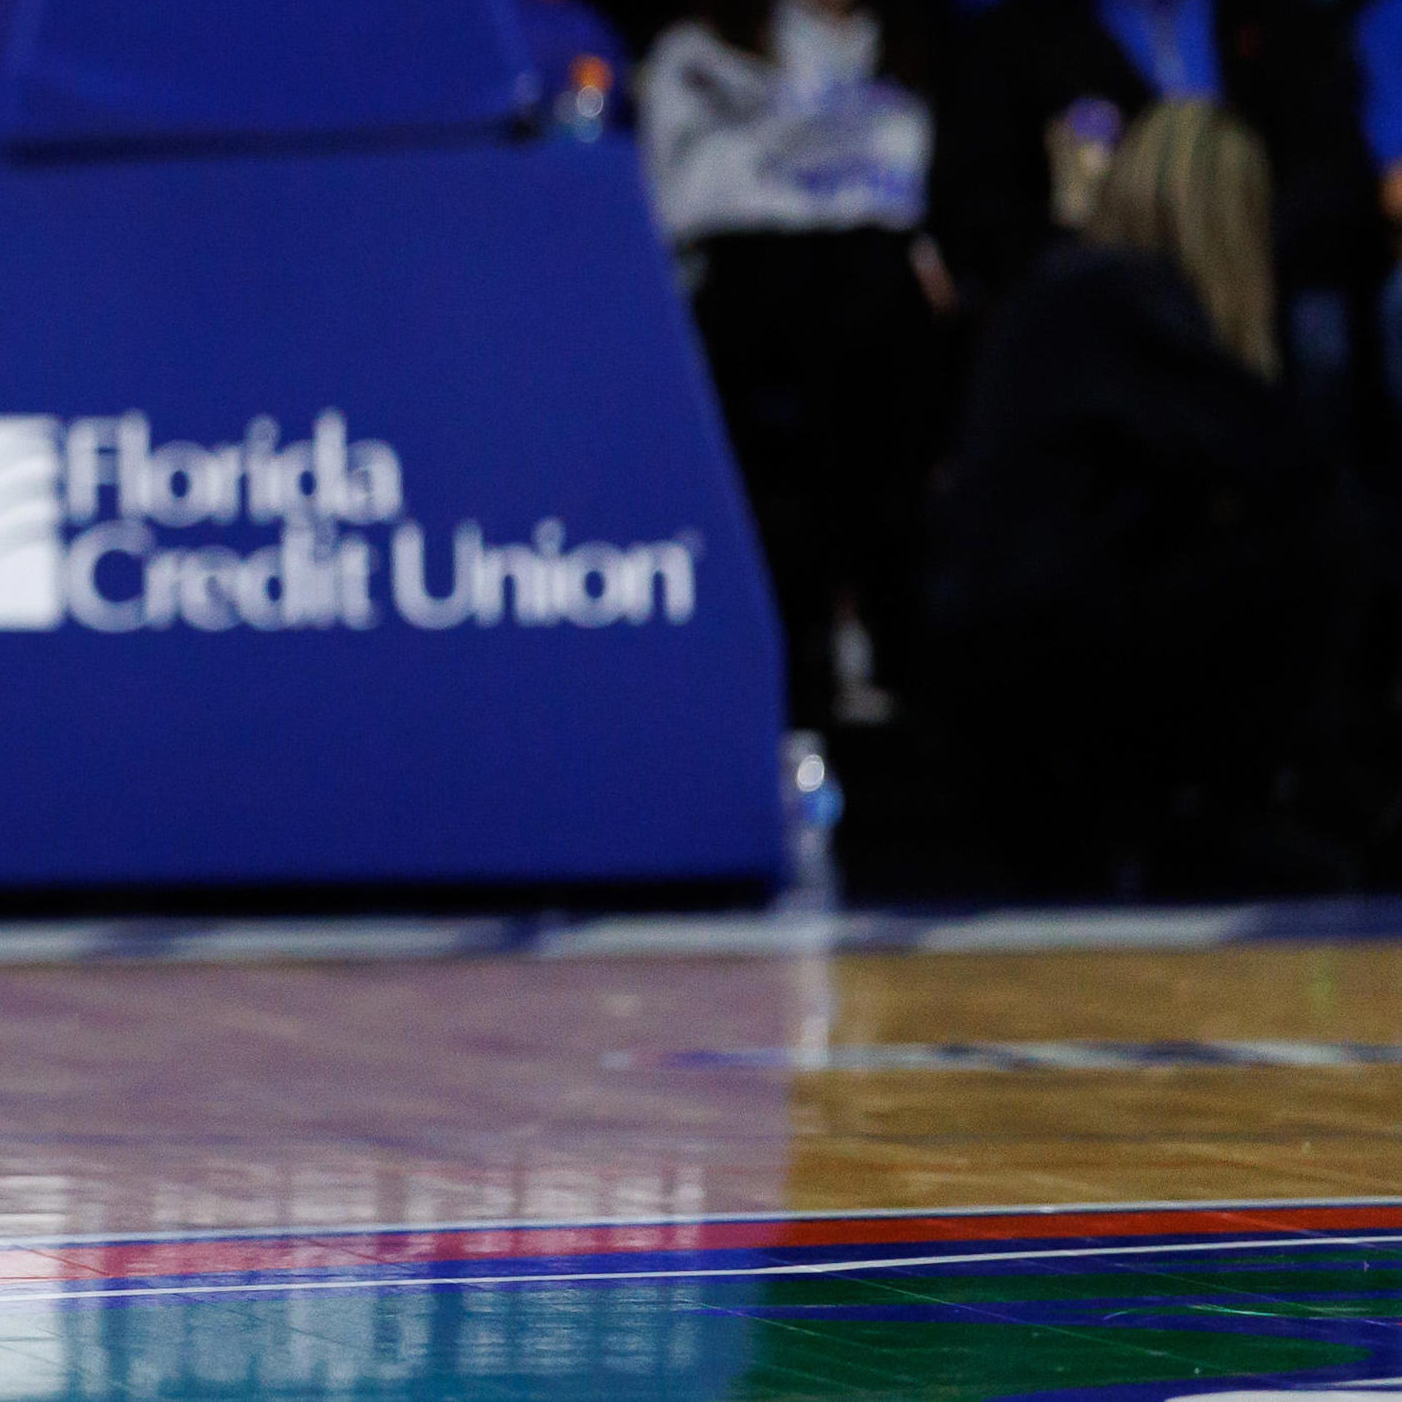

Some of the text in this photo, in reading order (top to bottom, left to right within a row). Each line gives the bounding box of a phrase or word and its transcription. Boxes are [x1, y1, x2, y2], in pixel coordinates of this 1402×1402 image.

[64, 408, 404, 528] Florida
[64, 517, 696, 632] Credit Union
